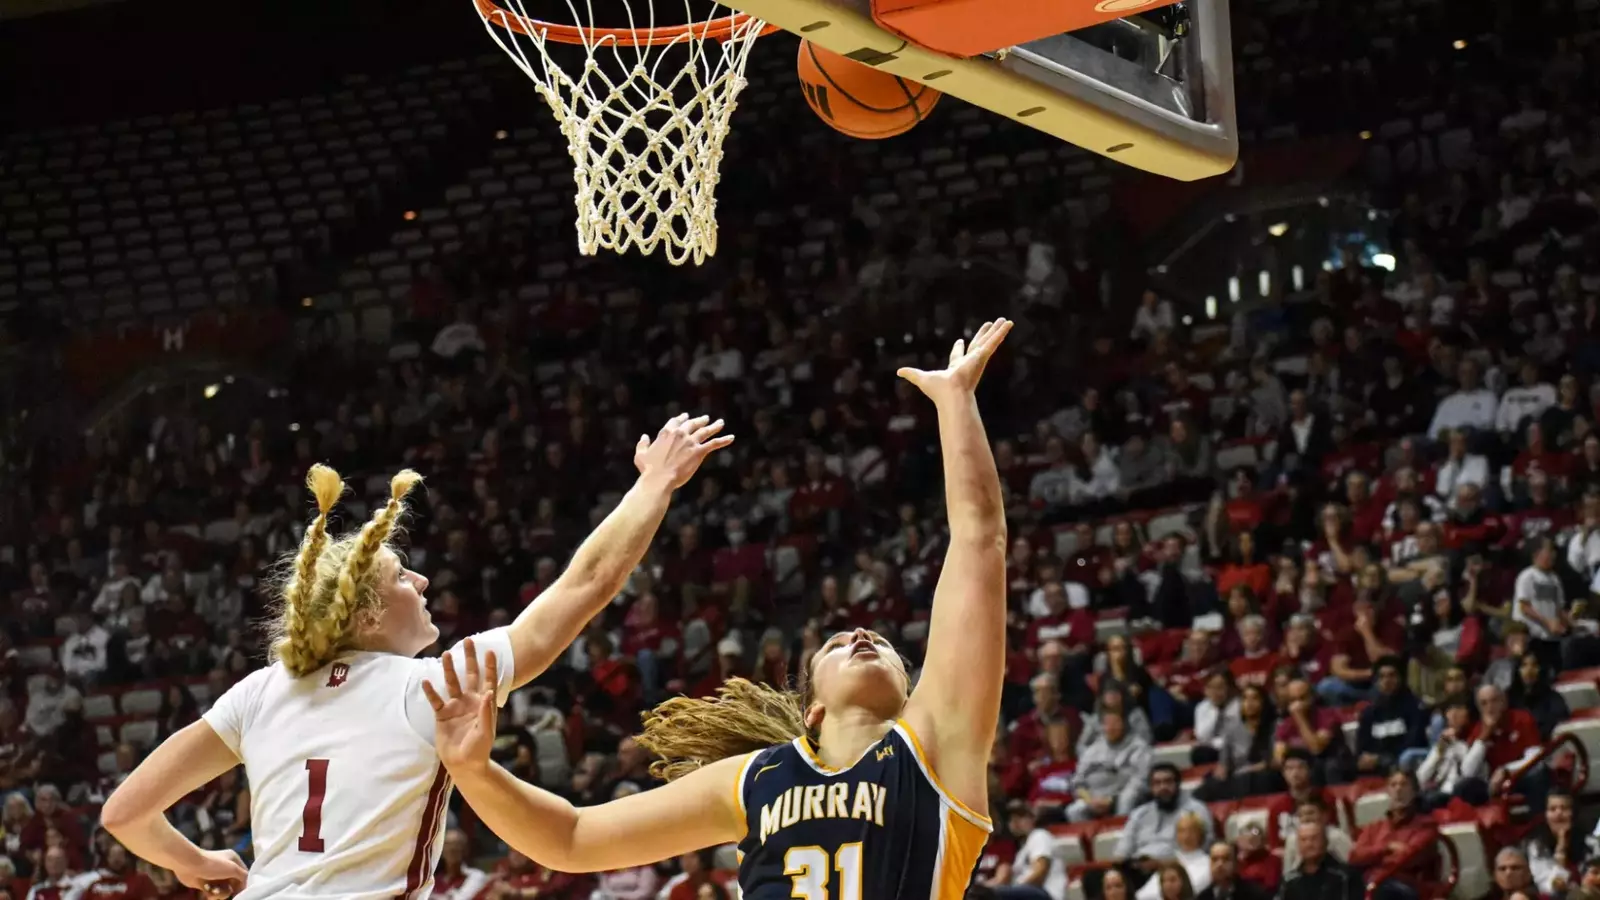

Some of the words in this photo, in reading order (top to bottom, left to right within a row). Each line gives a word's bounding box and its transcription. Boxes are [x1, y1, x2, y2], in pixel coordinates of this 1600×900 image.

[298, 759, 330, 853] 1
[760, 781, 886, 846] MURRAY
[783, 841, 863, 900] 31
